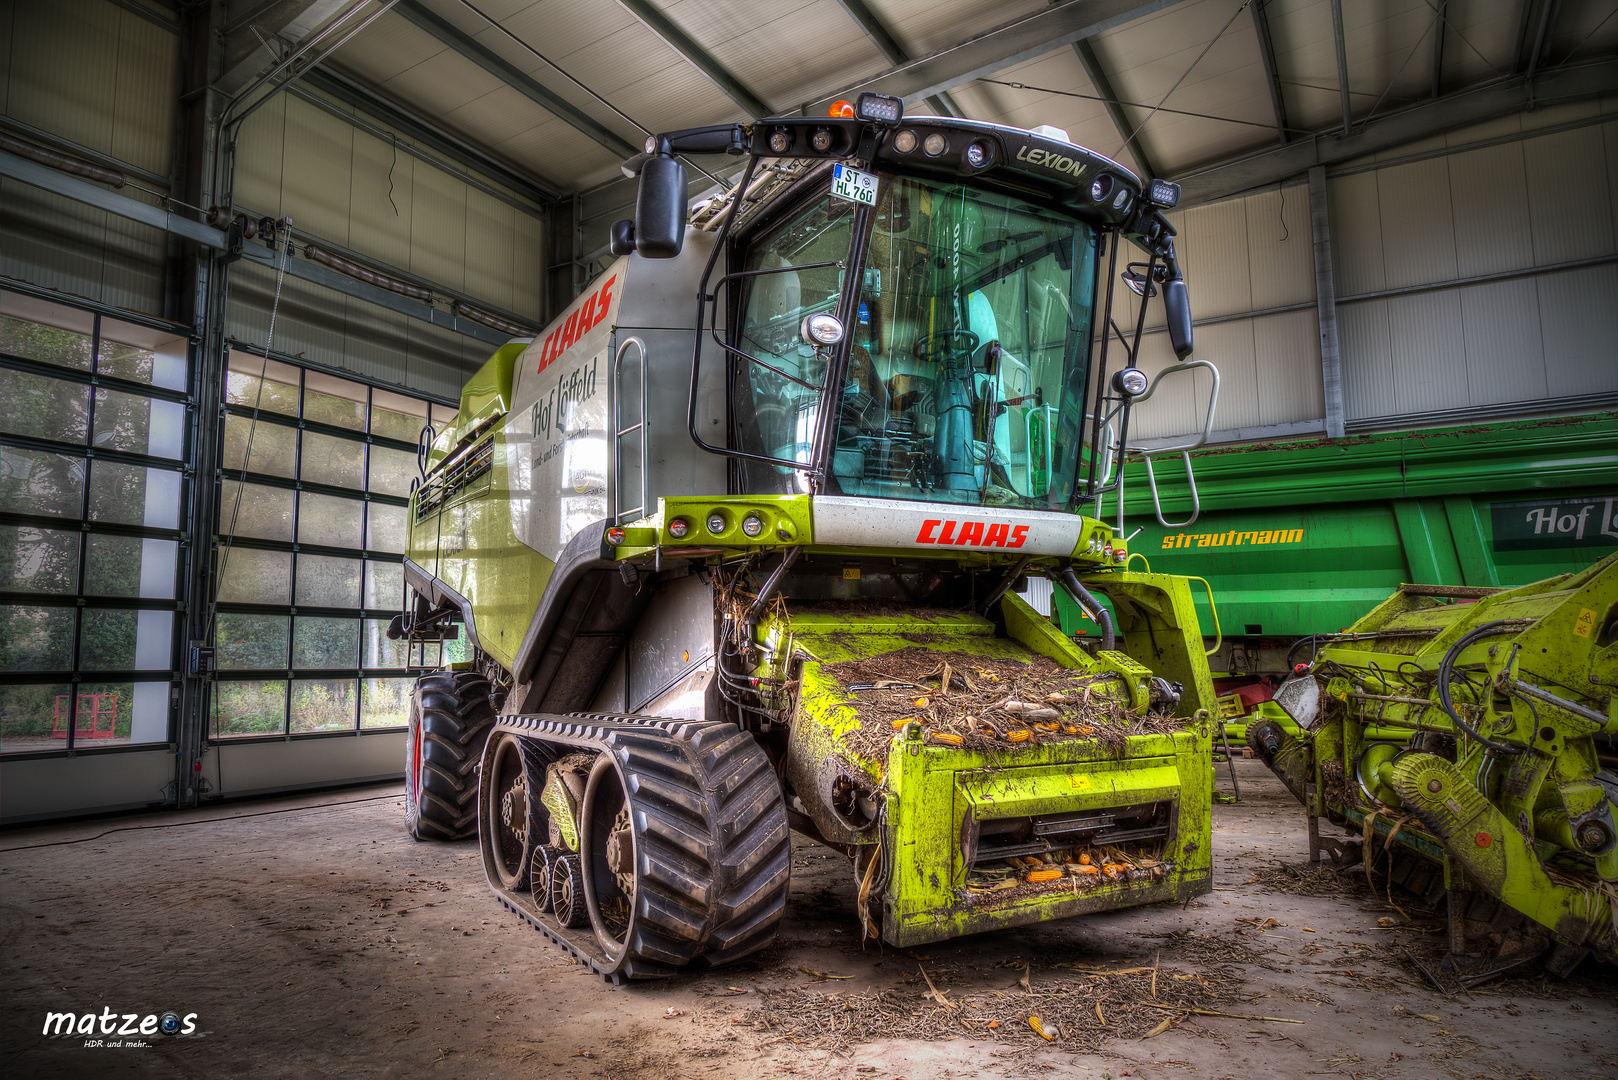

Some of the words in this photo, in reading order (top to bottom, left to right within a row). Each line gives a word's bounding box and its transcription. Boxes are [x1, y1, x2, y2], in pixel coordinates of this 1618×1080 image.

[845, 169, 860, 185] ST
[1016, 145, 1088, 178] LEXION
[836, 180, 851, 196] HL
[853, 185, 873, 203] 760
[538, 273, 617, 375] CLAAS
[532, 388, 555, 441] Hof
[556, 356, 597, 434] Löffeld
[916, 519, 1030, 548] CLAAS
[1526, 505, 1595, 540] Hof
[1161, 528, 1304, 549] strautmann
